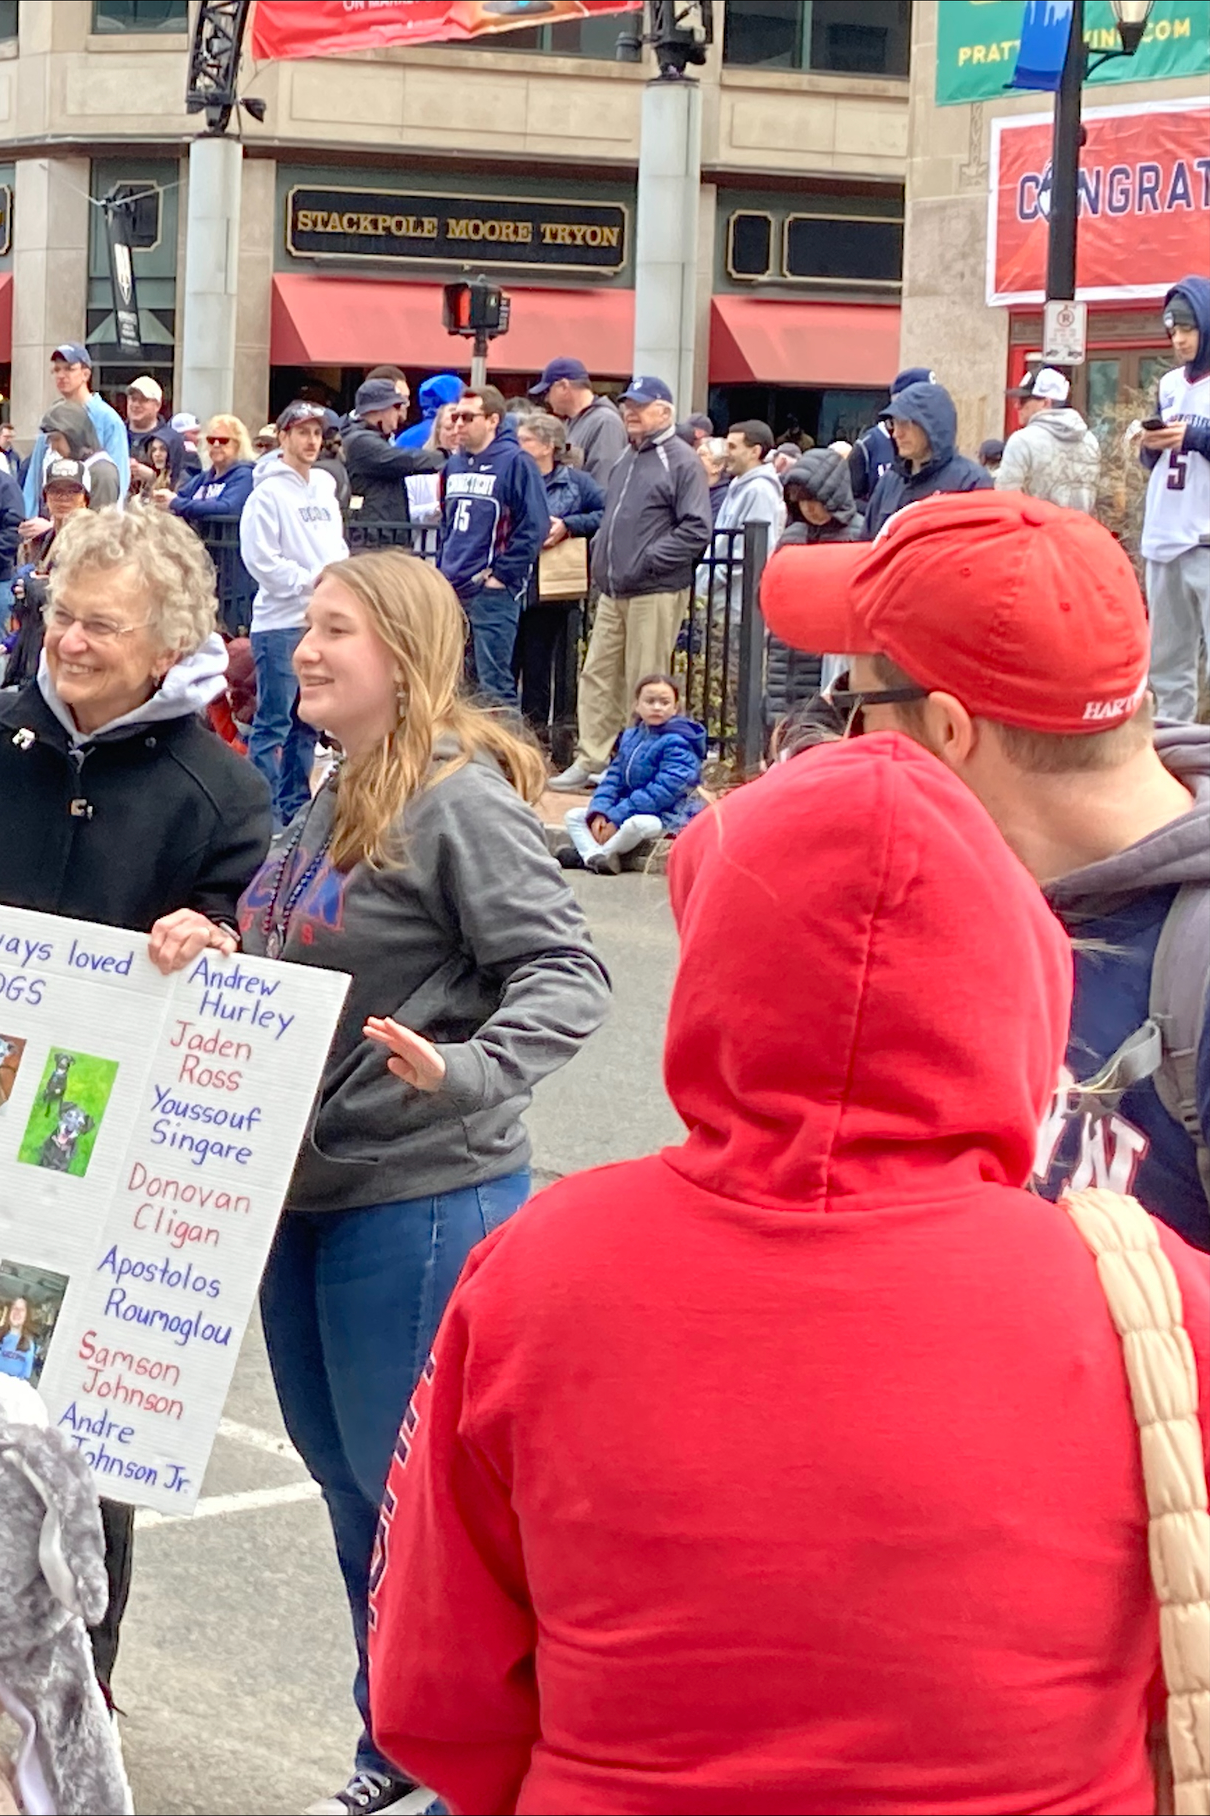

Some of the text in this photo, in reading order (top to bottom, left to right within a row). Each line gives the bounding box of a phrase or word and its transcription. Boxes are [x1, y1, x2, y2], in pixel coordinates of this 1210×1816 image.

[1017, 157, 1210, 223] CNGRAT
[297, 211, 620, 247] STACKPOLE MOORE TRYON
[68, 939, 135, 976] loved
[187, 956, 281, 997] Andrew
[199, 989, 295, 1041] Hurley
[169, 1018, 253, 1062] Jaden
[178, 1053, 243, 1092] Ross
[150, 1083, 262, 1132] Youssouf
[150, 1118, 253, 1167] Singare
[127, 1160, 252, 1214] Donovan
[132, 1202, 220, 1249] Cligan
[97, 1243, 222, 1299] Apostolos
[104, 1286, 233, 1347] Roumoglou
[77, 1329, 181, 1387] Samson
[81, 1364, 185, 1420] Johnson
[57, 1401, 135, 1444] Andre
[163, 1463, 192, 1494] Jr.
